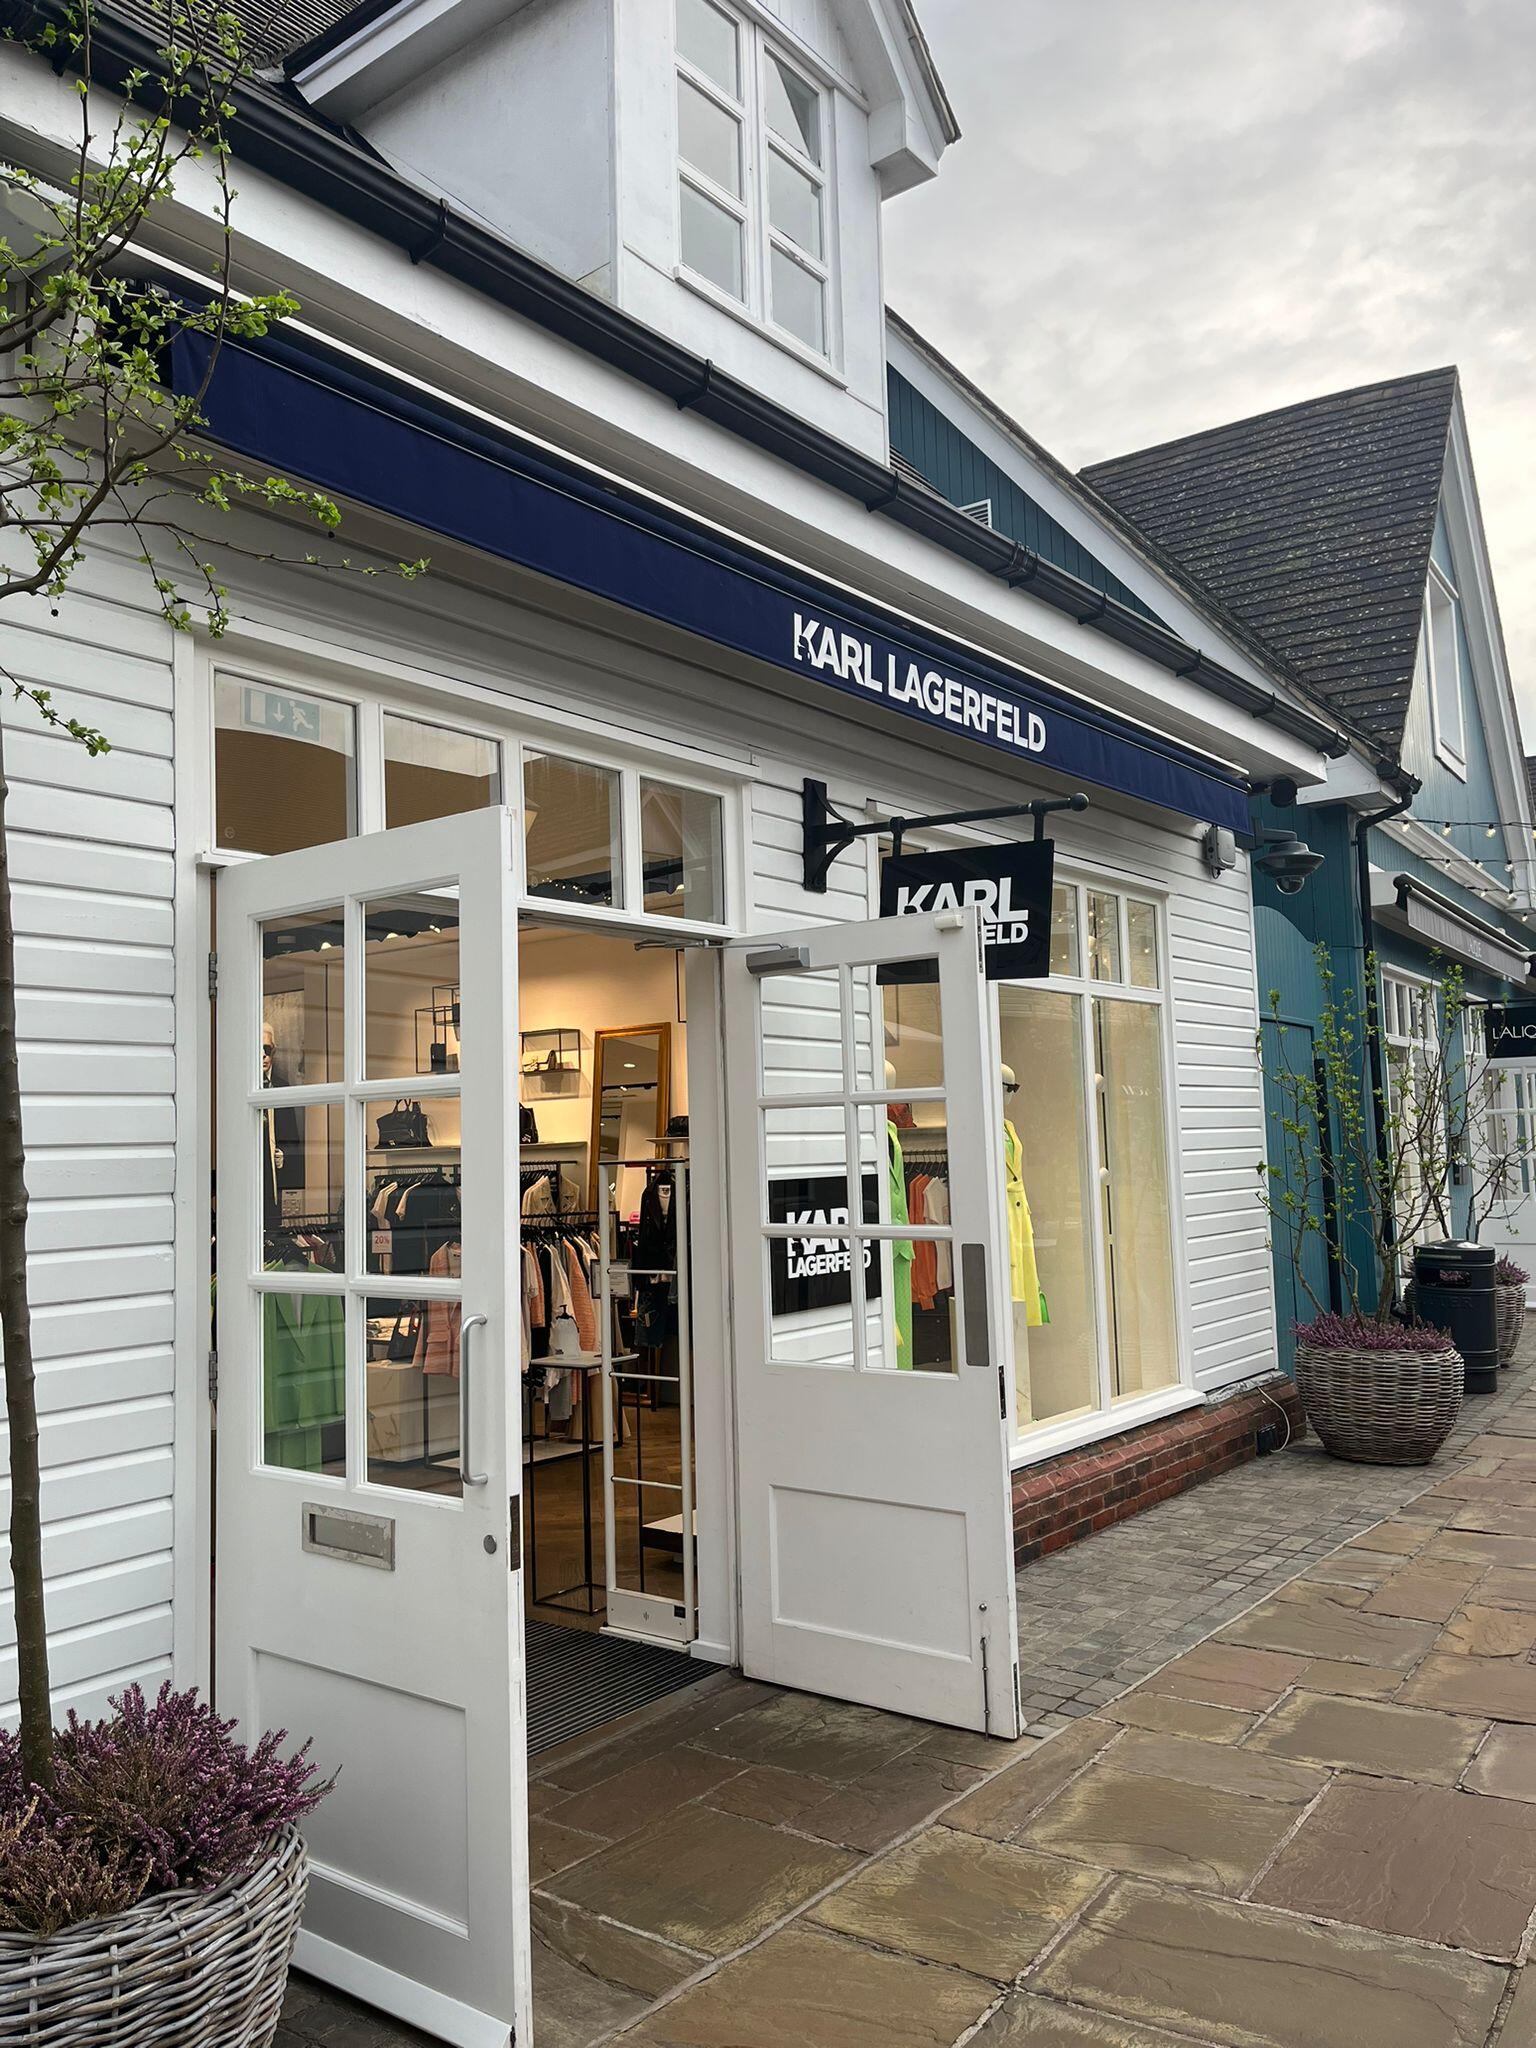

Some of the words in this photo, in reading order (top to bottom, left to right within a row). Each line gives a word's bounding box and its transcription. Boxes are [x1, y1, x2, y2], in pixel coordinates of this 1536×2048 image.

[793, 612, 883, 692] KARL
[888, 653, 1046, 753] LAGERFELD
[897, 876, 1029, 924] KARL
[786, 1207, 871, 1257] KAR
[787, 1249, 872, 1279] LAGERFED
